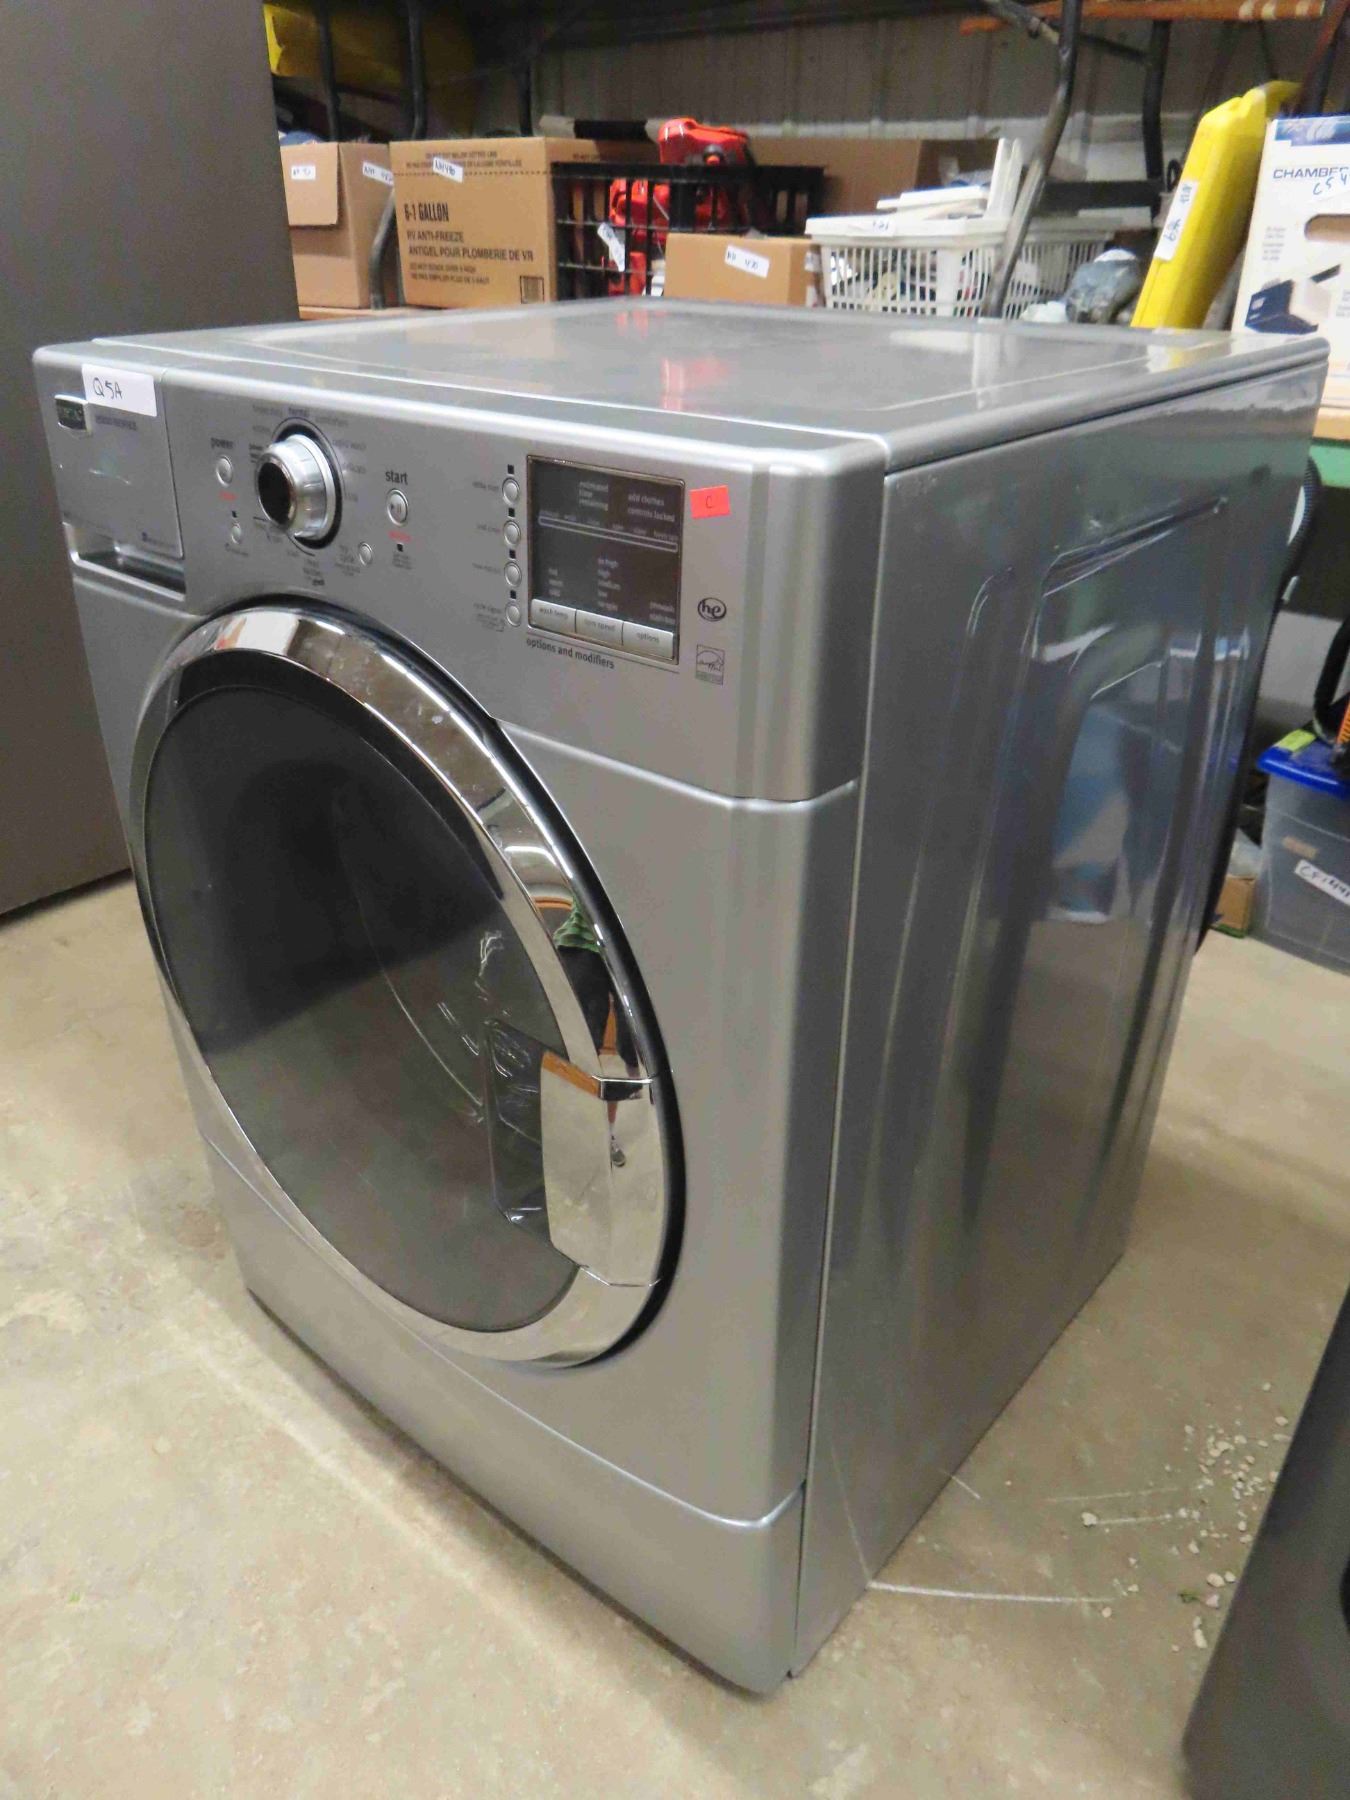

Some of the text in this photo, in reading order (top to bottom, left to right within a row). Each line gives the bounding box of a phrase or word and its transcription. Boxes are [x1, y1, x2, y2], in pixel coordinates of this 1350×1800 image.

[418, 202, 450, 222] GALLON
[418, 230, 464, 243] ANTI-FREEZE
[409, 245, 534, 262] ANTIGEL POUR PLOMBERIE DE VR
[385, 469, 409, 486] start
[526, 636, 616, 670] options and modifiers
